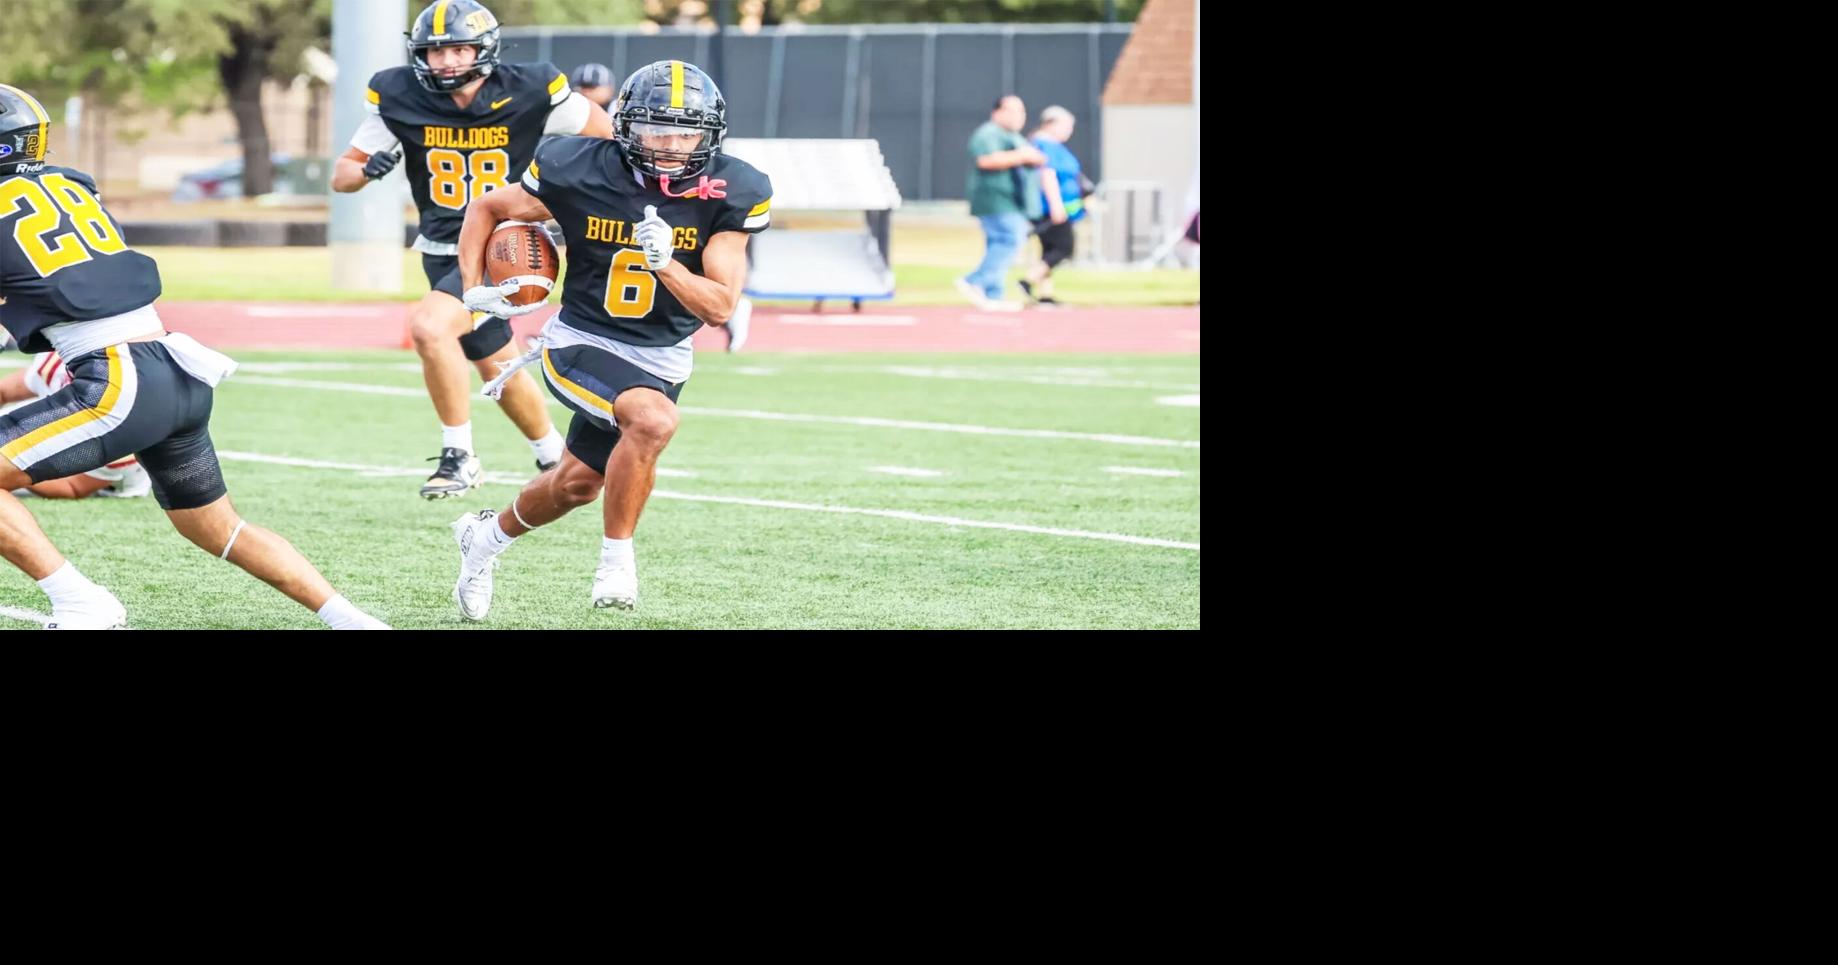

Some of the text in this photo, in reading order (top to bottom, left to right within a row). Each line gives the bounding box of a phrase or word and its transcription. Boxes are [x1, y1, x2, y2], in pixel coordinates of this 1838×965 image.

[424, 126, 509, 149] BULLDOGS
[426, 147, 510, 211] 88
[0, 172, 128, 278] 28
[585, 215, 698, 250] BULLGS
[603, 247, 657, 319] 6
